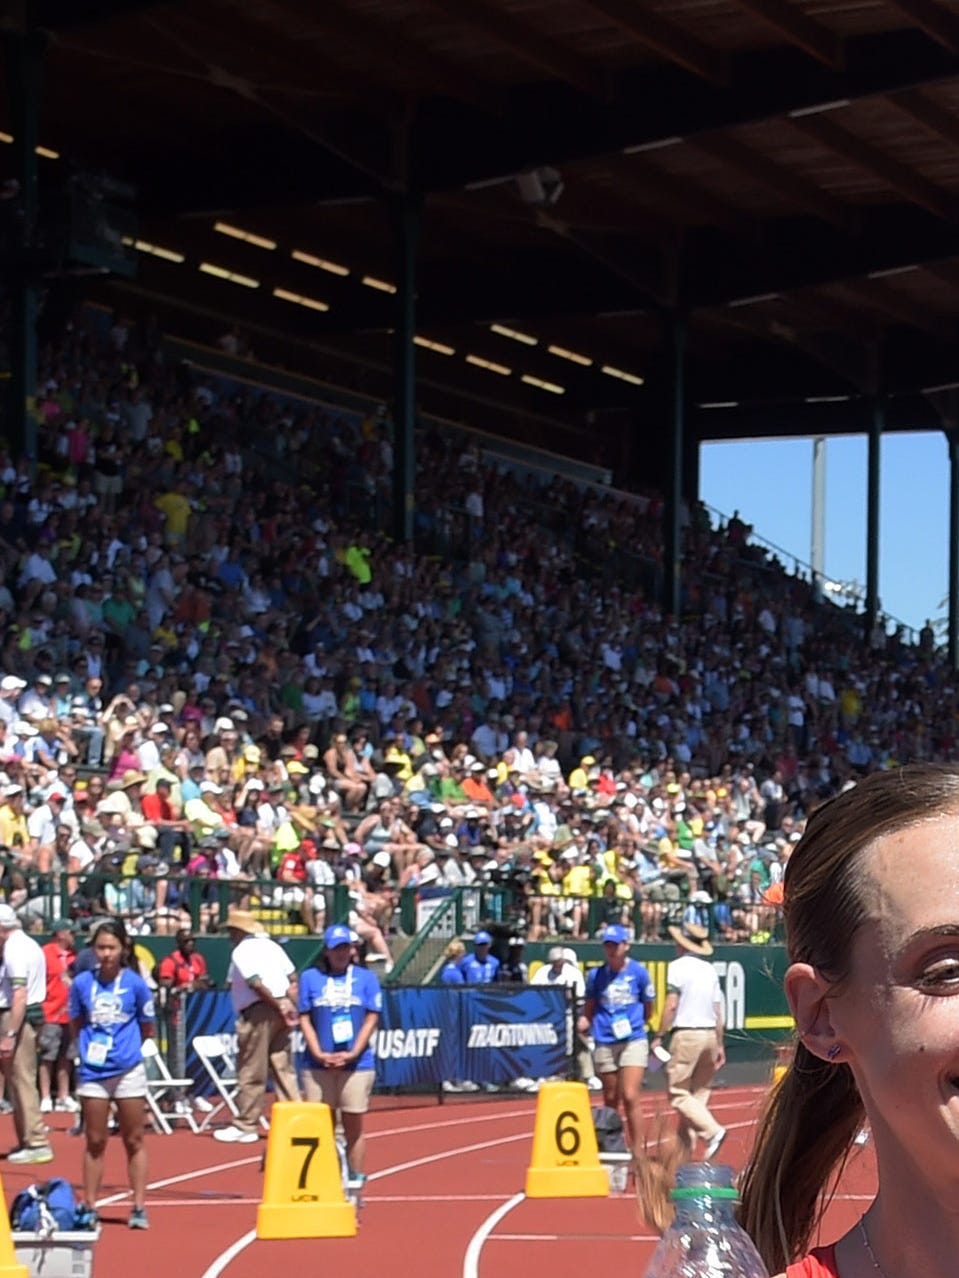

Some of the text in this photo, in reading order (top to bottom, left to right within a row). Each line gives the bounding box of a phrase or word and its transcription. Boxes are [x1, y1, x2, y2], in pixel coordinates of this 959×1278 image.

[377, 1028, 440, 1059] USATF
[555, 1110, 581, 1156] 6
[290, 1137, 320, 1189] 7
